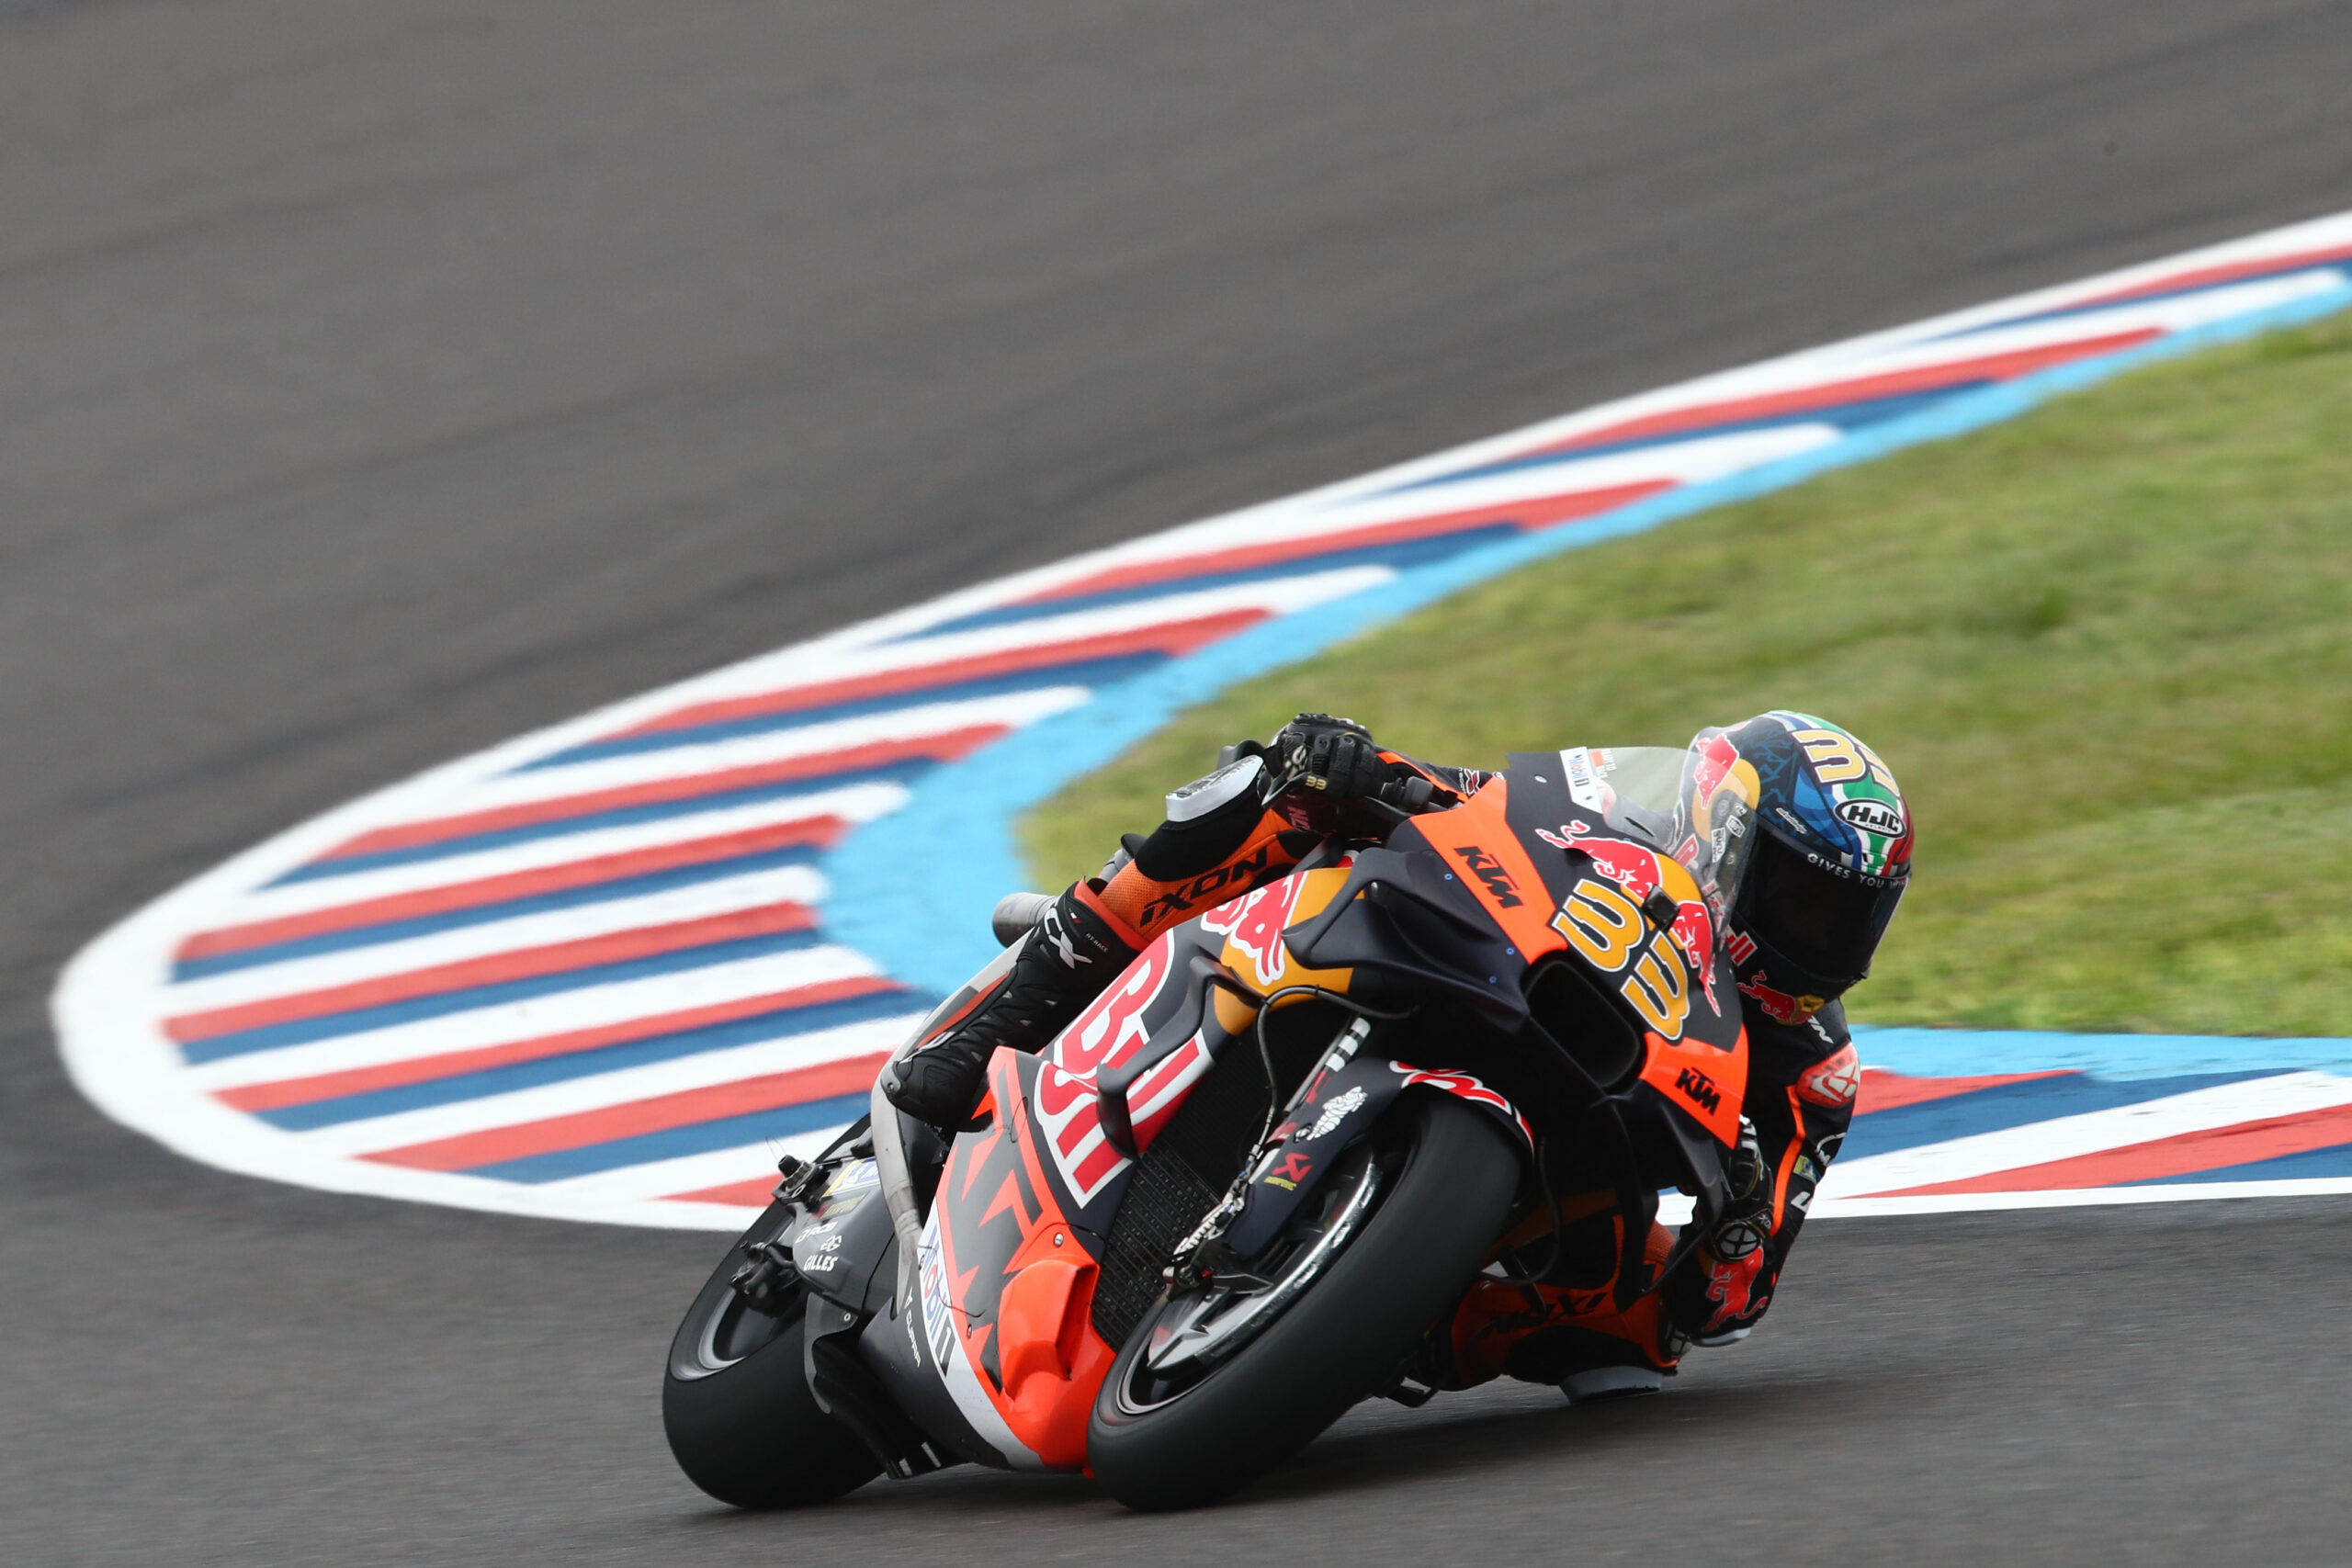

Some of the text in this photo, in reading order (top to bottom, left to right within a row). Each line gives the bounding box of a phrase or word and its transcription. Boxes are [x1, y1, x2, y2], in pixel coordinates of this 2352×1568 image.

[1306, 774, 1329, 791] 33
[1847, 805, 1900, 832] HJC
[1453, 845, 1524, 909] KTM
[1806, 852, 1851, 879] GIVES
[1859, 874, 1884, 889] YOU
[1551, 878, 1690, 1041] 33
[1674, 1066, 1721, 1117] KTM
[803, 1254, 839, 1272] GILLES
[922, 1224, 956, 1378] Mobil 1
[905, 1308, 922, 1369] CUPRA
